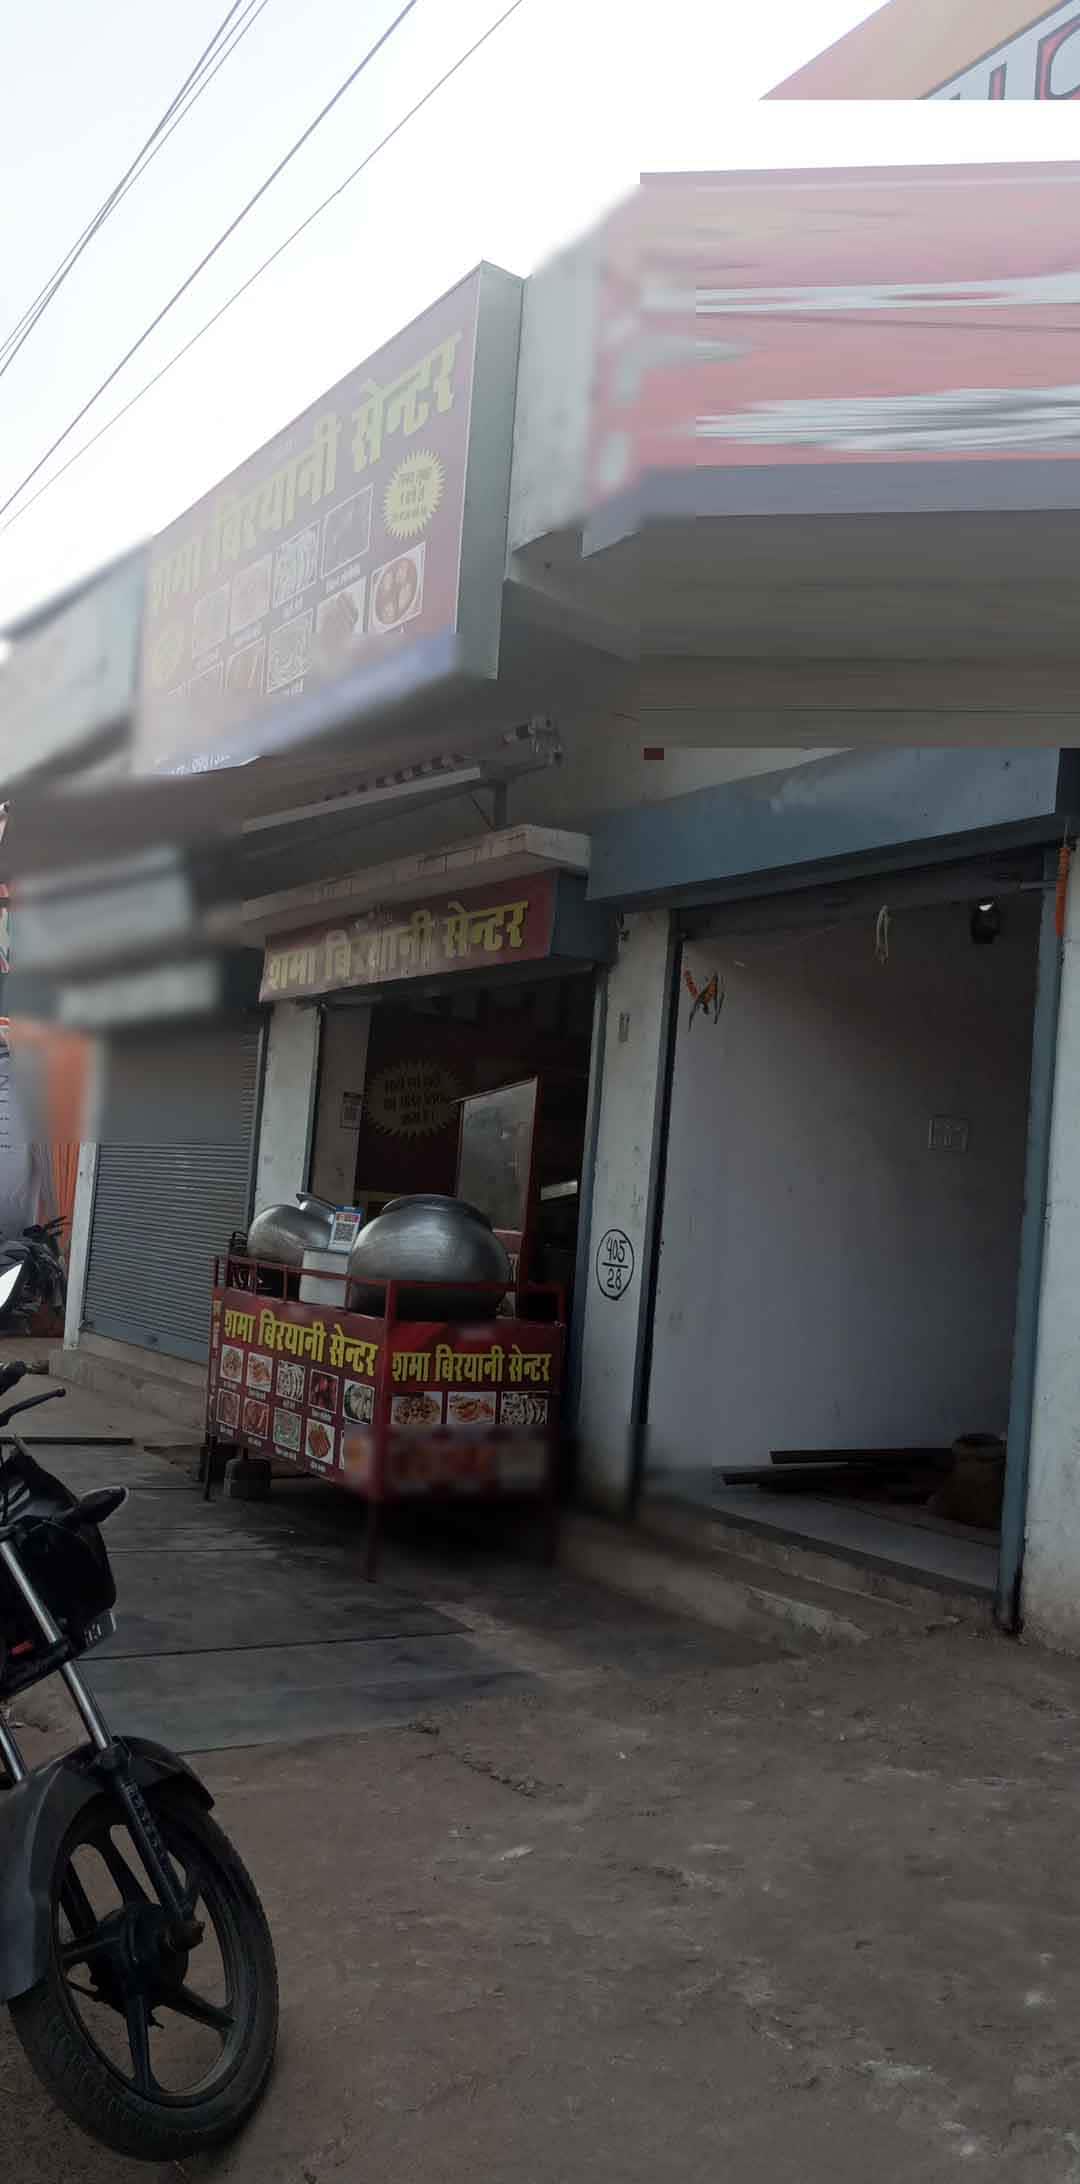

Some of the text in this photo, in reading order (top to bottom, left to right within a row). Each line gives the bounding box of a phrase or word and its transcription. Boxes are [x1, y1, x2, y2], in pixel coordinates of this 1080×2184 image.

[213, 412, 342, 562] बिरयानी
[351, 332, 463, 473] सेन्टर
[268, 900, 529, 990] शमा बिरयानी सेन्टर
[607, 1237, 627, 1262] 405
[607, 1268, 622, 1290] 28
[223, 1309, 254, 1343] शमा
[258, 1308, 327, 1365] बिरयानी
[328, 1323, 379, 1377] सेन्टर
[392, 1344, 553, 1383] शमा बिरयानी सेन्टर
